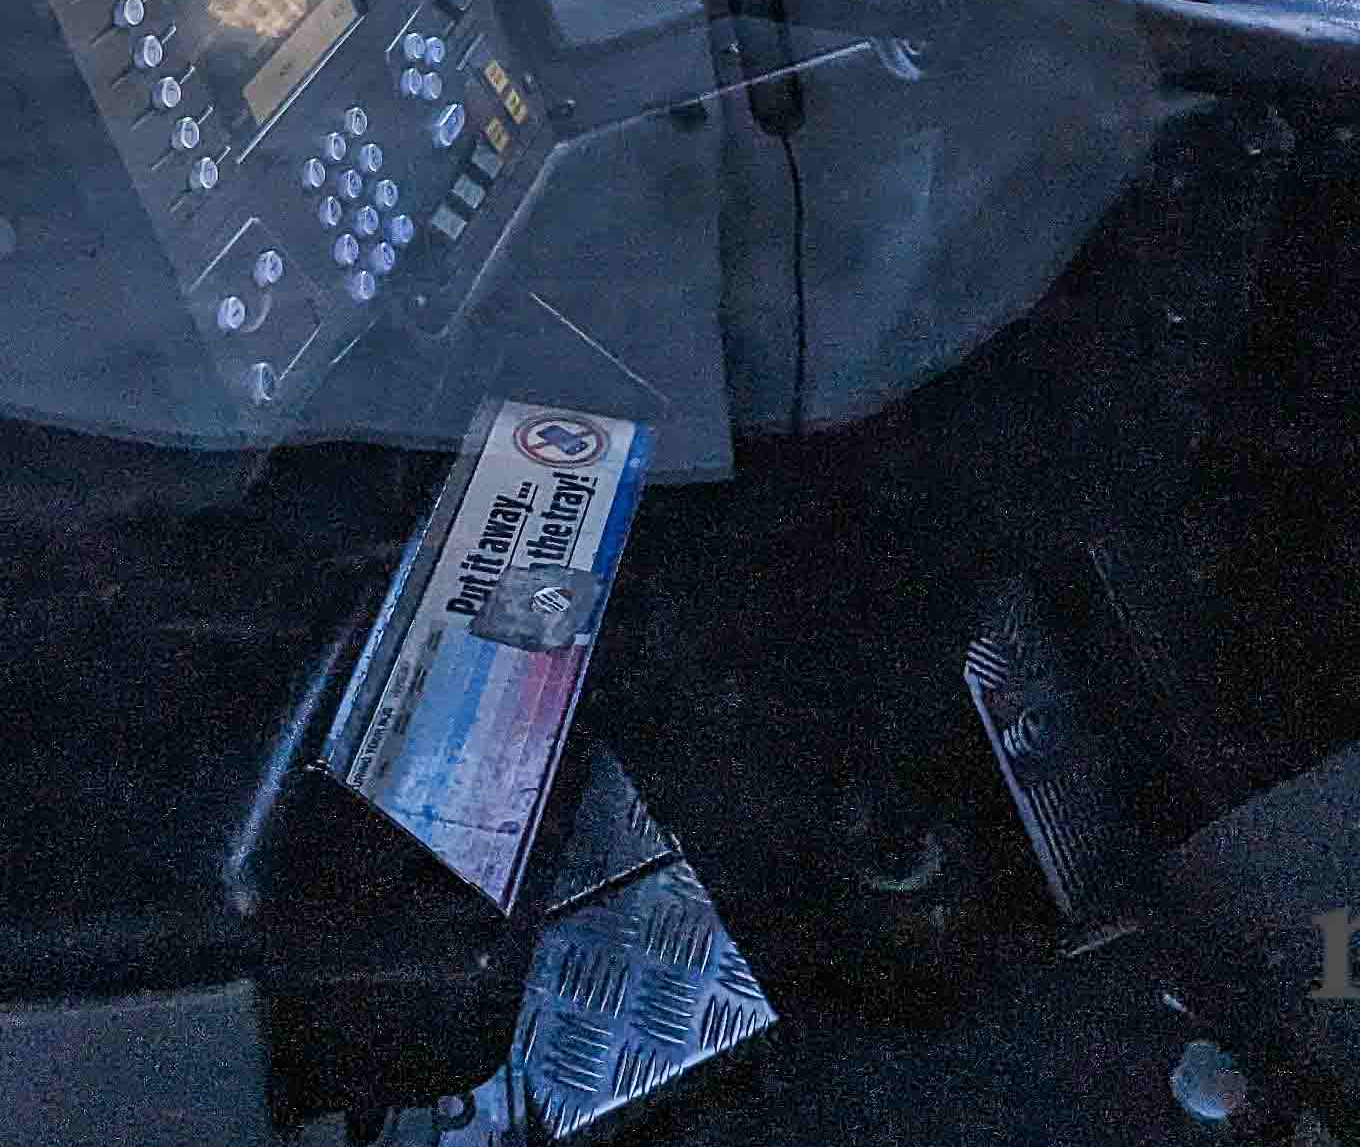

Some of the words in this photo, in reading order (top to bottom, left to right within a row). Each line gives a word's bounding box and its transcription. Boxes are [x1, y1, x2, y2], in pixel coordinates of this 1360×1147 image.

[541, 471, 596, 521] tray!
[477, 481, 534, 554] away...
[526, 522, 574, 561] the
[460, 553, 505, 575] it
[446, 574, 500, 616] Put
